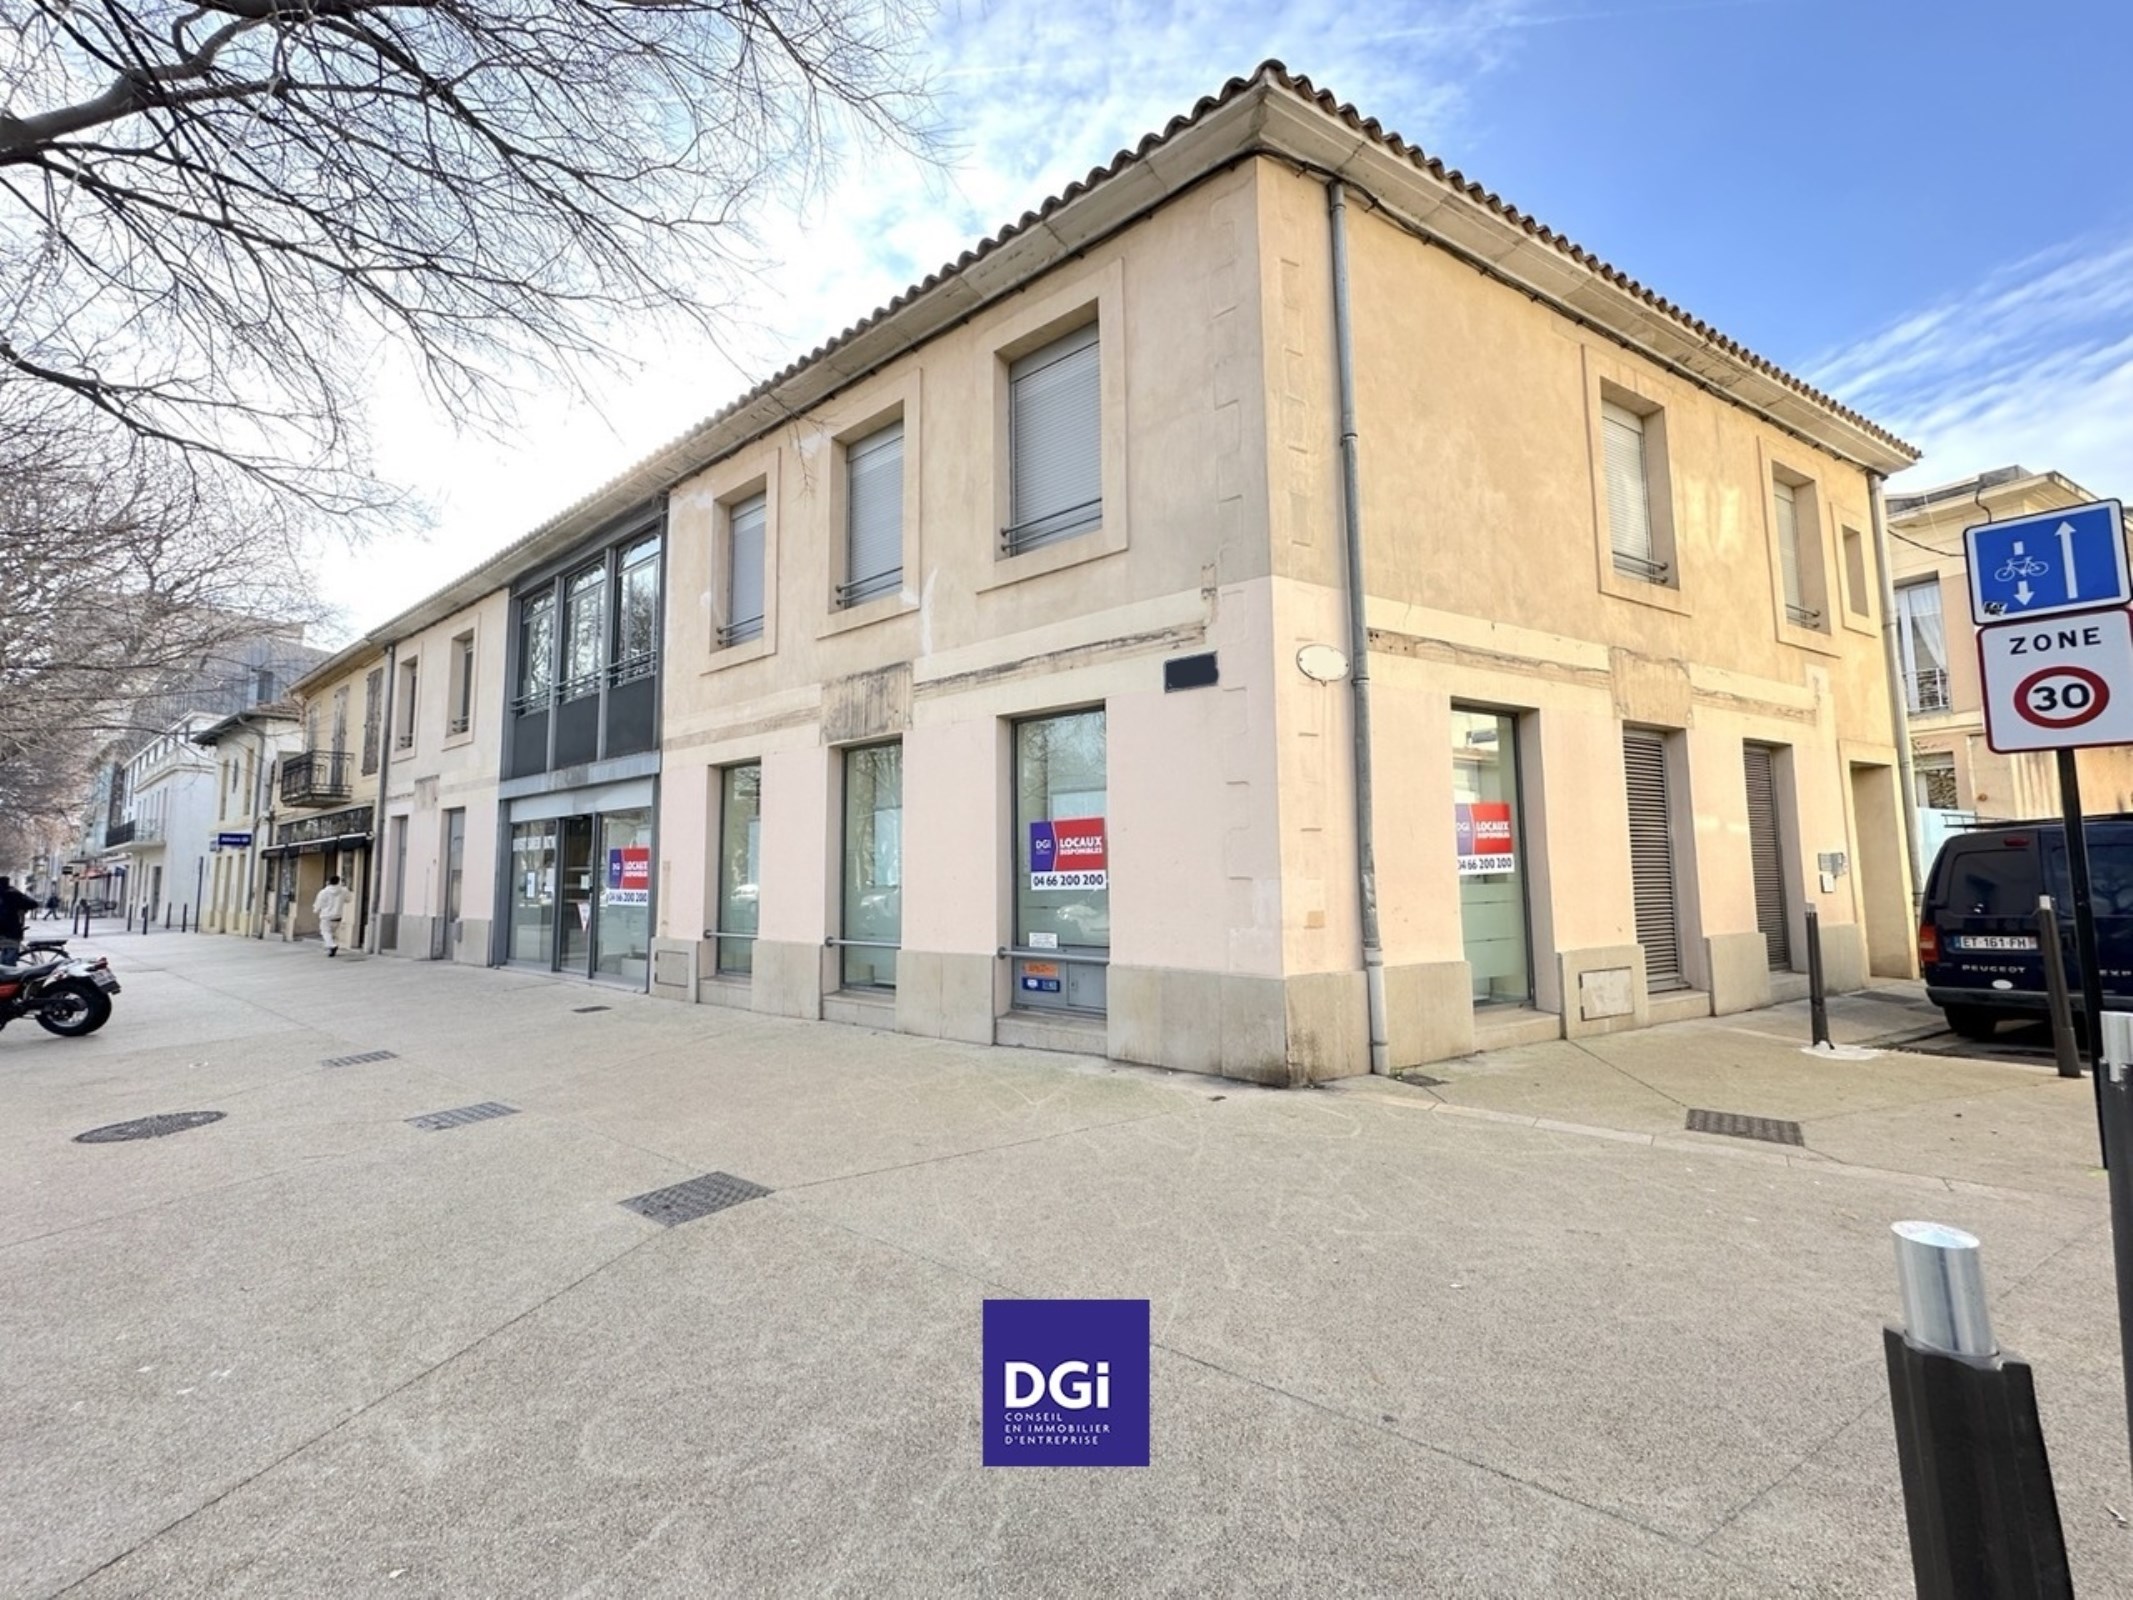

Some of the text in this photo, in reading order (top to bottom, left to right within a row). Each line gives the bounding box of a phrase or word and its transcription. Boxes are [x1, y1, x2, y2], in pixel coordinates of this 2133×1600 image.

[2009, 626, 2102, 655] ZONE
[2032, 683, 2091, 712] 30
[1059, 836, 1102, 848] LOCAUX
[1033, 874, 1103, 887] 04 66 200 200
[1962, 964, 2026, 973] PEUGEOT
